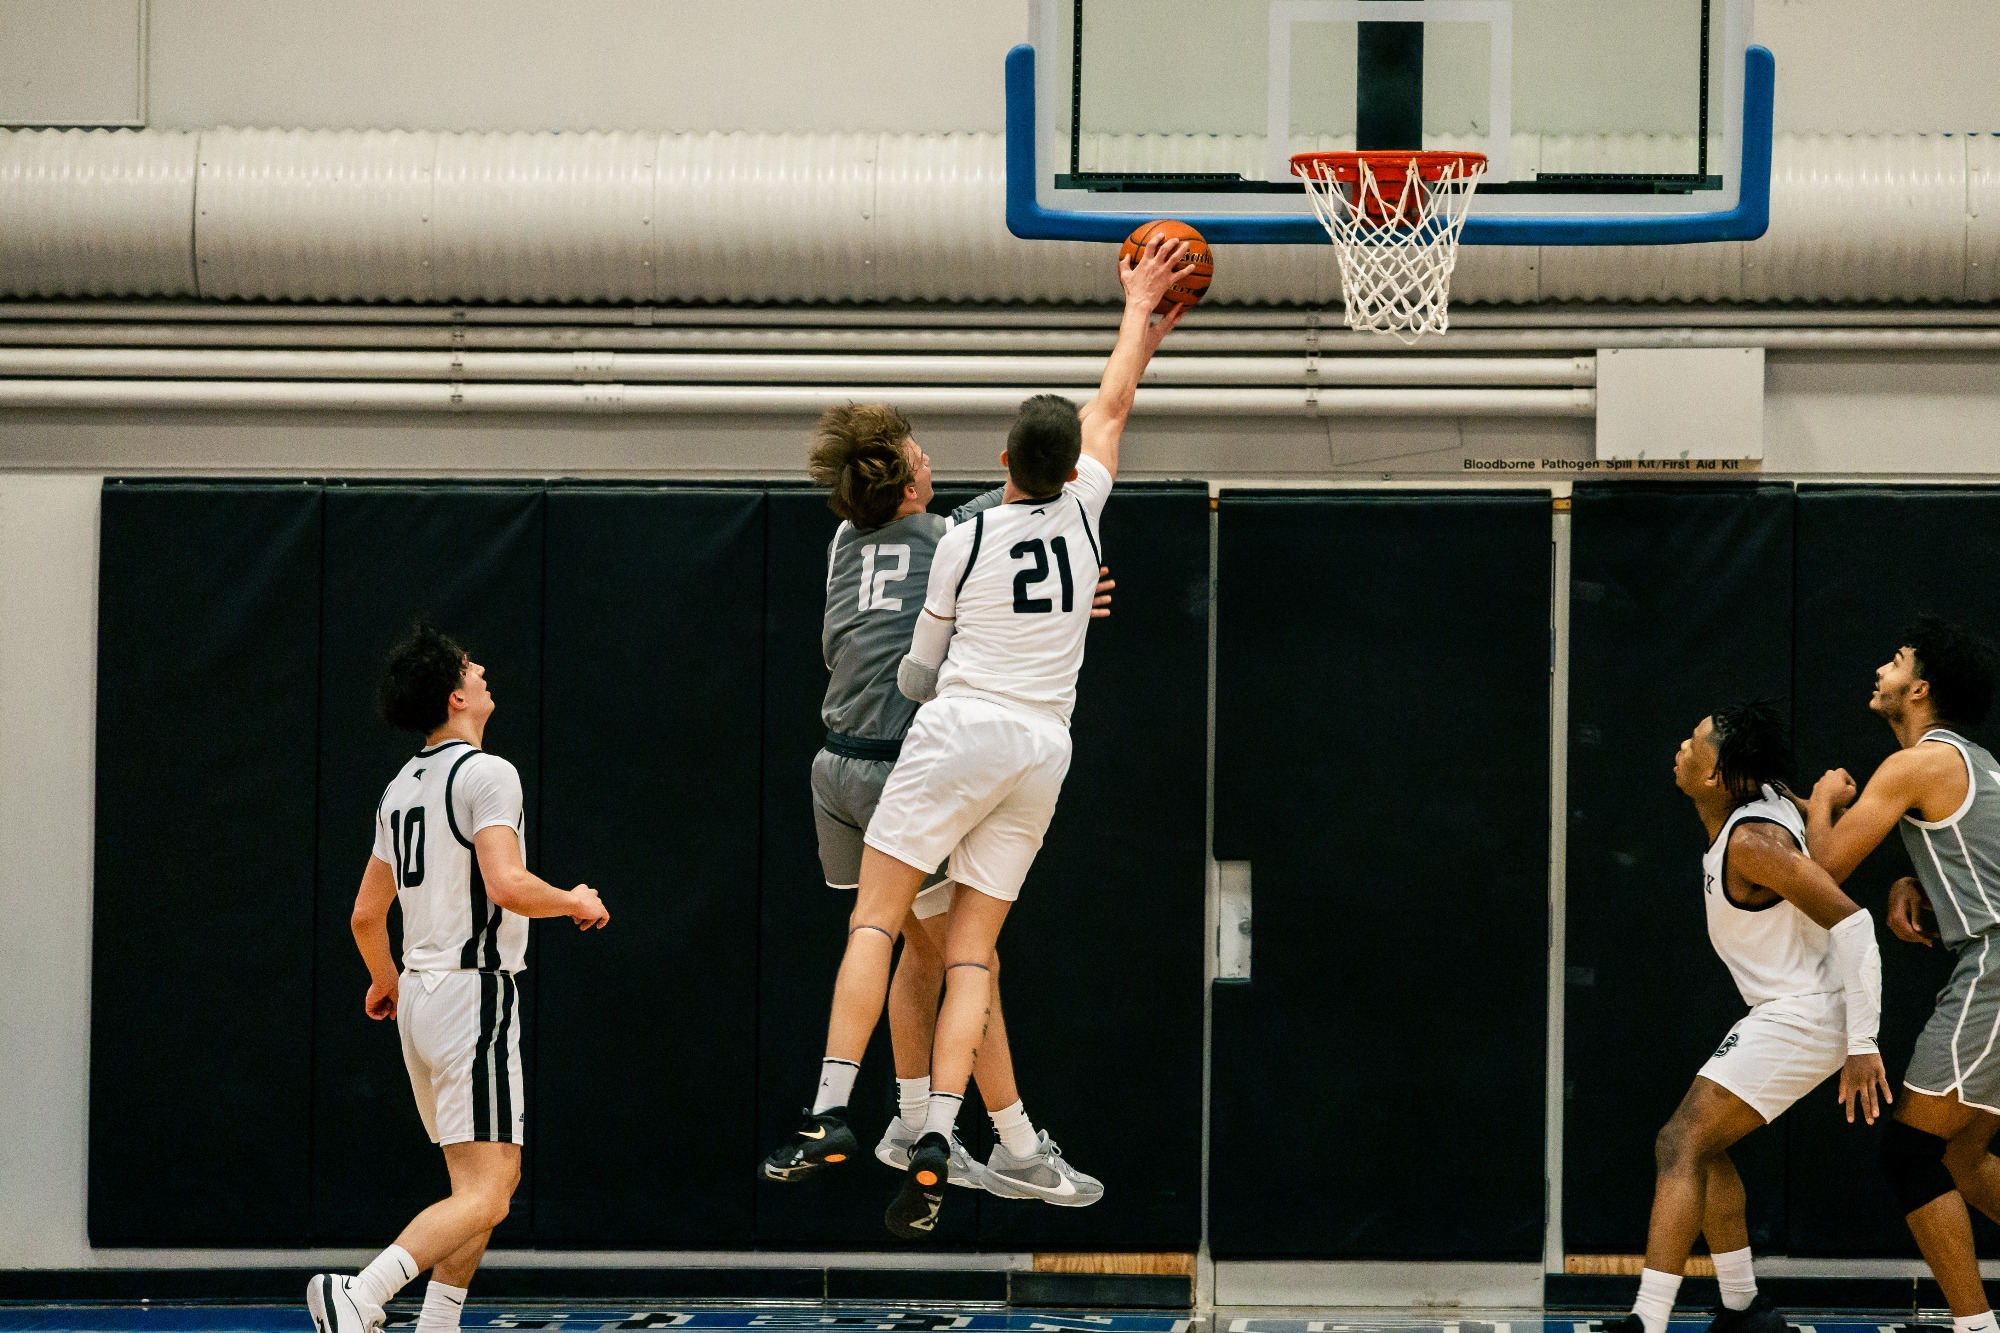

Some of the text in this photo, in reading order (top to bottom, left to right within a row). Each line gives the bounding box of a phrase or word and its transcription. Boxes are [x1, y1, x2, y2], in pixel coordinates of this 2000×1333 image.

[1463, 459, 1739, 471] Bloodborne Pathogen Spill Kit/First Aid Kit
[857, 543, 911, 612] 12
[1010, 536, 1074, 613] 21
[390, 806, 425, 890] 10
